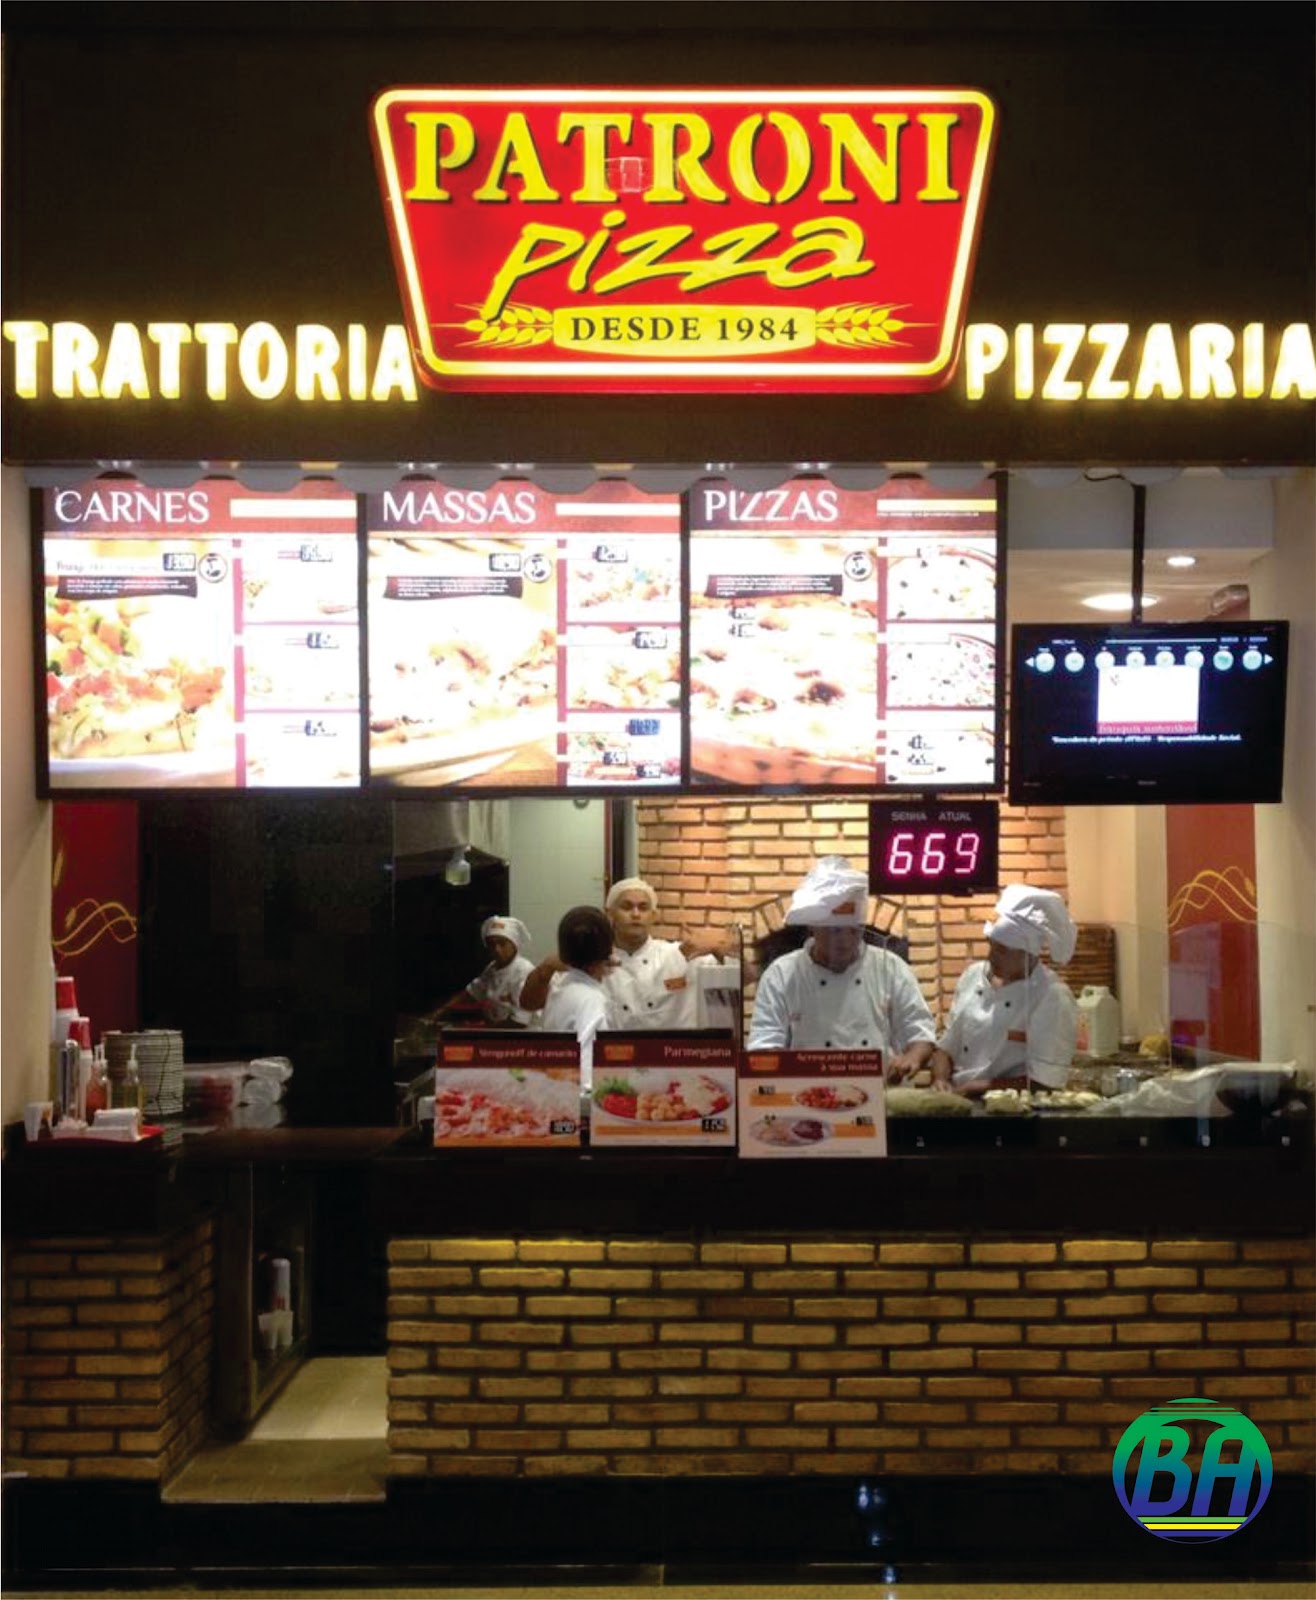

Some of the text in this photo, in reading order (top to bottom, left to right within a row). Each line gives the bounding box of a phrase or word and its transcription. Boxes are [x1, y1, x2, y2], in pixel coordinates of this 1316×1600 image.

[405, 111, 961, 203] PATRONI
[481, 210, 875, 321] pizza
[571, 316, 799, 341] DESDE 1984
[3, 320, 419, 401] TRATTORIA
[964, 321, 1316, 400] PIZZARIA
[55, 490, 210, 523] CARNES
[382, 490, 537, 524] MASSAS
[703, 489, 839, 522] PIZZAS
[891, 811, 972, 822] SENHA ATUAL
[888, 832, 980, 875] 669
[664, 1045, 732, 1060] Parmegiana
